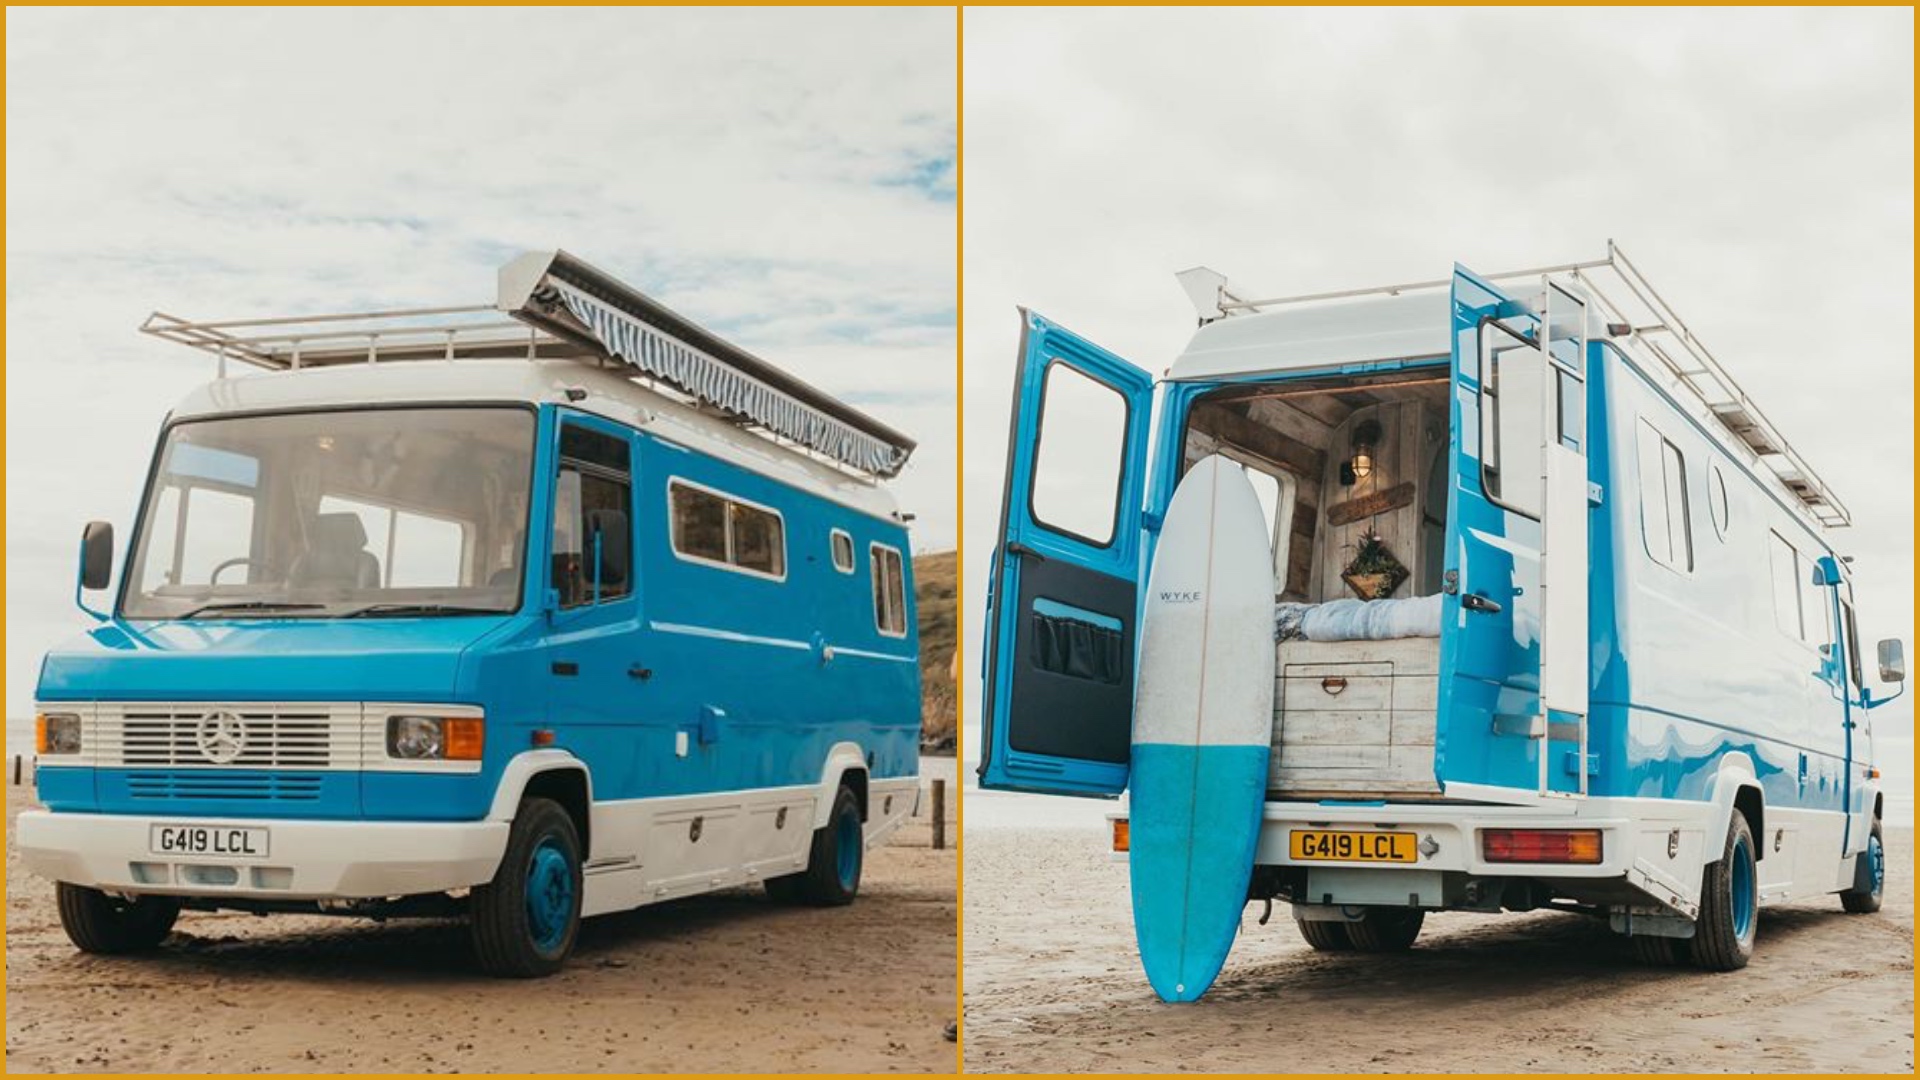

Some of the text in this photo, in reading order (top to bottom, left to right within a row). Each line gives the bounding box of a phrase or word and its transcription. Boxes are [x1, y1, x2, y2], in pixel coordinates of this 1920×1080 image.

[1160, 591, 1202, 600] WYKE
[161, 828, 256, 853] G419 LCL
[1302, 834, 1403, 859] G419 LCL
